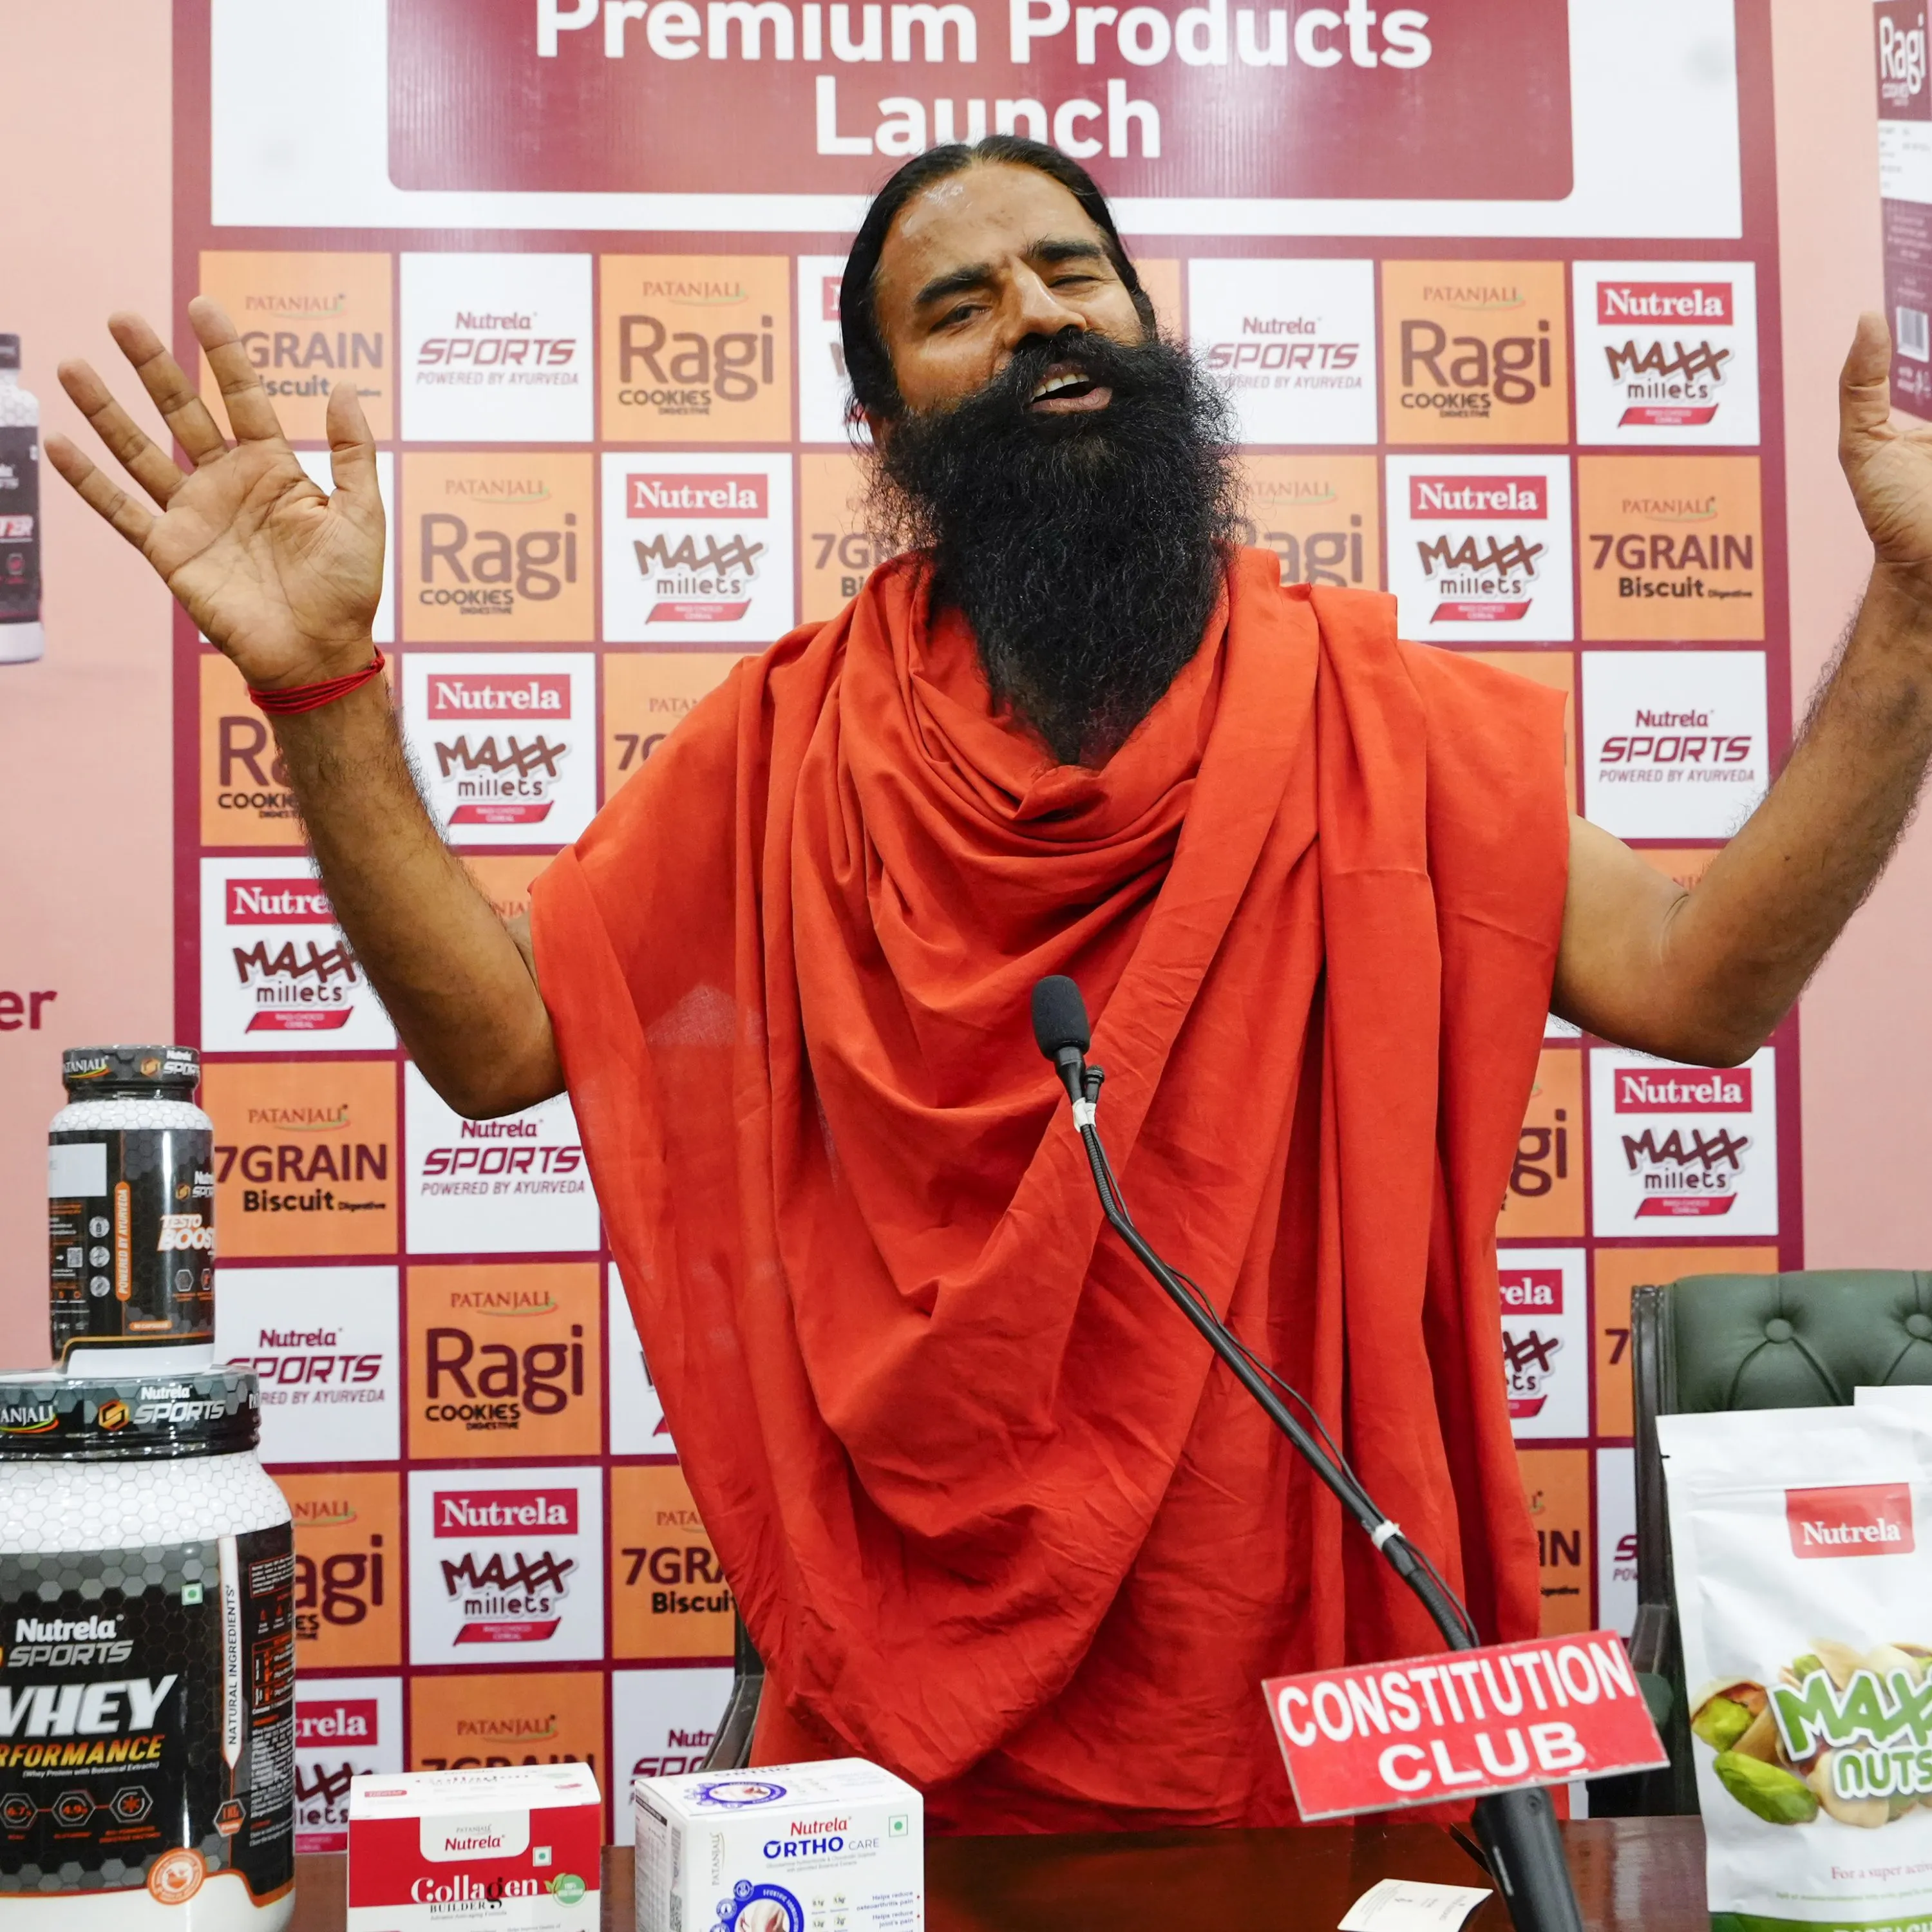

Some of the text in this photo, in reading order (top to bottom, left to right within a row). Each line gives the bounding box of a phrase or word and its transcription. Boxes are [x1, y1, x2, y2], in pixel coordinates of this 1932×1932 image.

[537, 0, 1433, 69] Premium Products
[1879, 13, 1926, 95] Ragi
[815, 75, 1162, 158] Launch
[643, 281, 742, 299] PATANJALI
[1423, 286, 1520, 305] PATANJALI
[245, 294, 340, 312] PATANJALI
[1604, 289, 1725, 317] Nutrela
[455, 312, 531, 330] Nutrela
[1243, 317, 1316, 335] Nutrela
[240, 331, 383, 370] GRAIN
[417, 339, 576, 366] SPORTS
[619, 314, 775, 402] Ragi
[1208, 343, 1359, 370] SPORTS
[1400, 320, 1551, 405] Ragi
[1604, 341, 1731, 381] MAXX
[259, 374, 330, 397] scuit
[416, 372, 579, 386] POWERED BY AYURVEDA
[1274, 376, 1291, 388] BY
[1294, 375, 1363, 389] AYURVEDA
[1627, 380, 1709, 399] millets
[618, 390, 712, 406] COOKIES
[1401, 393, 1492, 409] COOKIES
[445, 479, 544, 497] PATANJALI
[634, 481, 759, 509] Nutrela
[1417, 482, 1539, 511] Nutrela
[1622, 498, 1710, 515] PATANJALI
[420, 513, 577, 601] Ragi
[632, 534, 764, 576] MAXX
[1416, 535, 1544, 576] MAXX
[1589, 534, 1754, 571] 7GRAIN
[656, 574, 741, 595] millets
[1439, 574, 1522, 594] millets
[1618, 576, 1704, 598] Biscuit
[419, 589, 514, 605] COOKIES
[434, 682, 562, 709] Nutrela
[1635, 710, 1709, 728] Nutrela
[434, 735, 567, 778] MAXX
[1599, 736, 1752, 762] SPORTS
[458, 776, 543, 796] millets
[1599, 769, 1755, 782] POWERED BY AYURVEDA
[218, 793, 295, 809] COOKI
[232, 887, 330, 915] Nutre
[256, 981, 342, 1003] millets
[0, 990, 58, 1030] er
[1622, 1075, 1744, 1104] Nutrela
[248, 1106, 344, 1126] PATANJALI
[461, 1120, 538, 1139] Nutrela
[422, 1146, 582, 1175] SPORTS
[1510, 1108, 1567, 1198] gi
[1622, 1128, 1748, 1171] MAXX
[215, 1142, 386, 1183] 7GRAIN
[421, 1180, 585, 1196] POWERED BY AYURVEDA
[1644, 1168, 1727, 1189] millets
[243, 1189, 334, 1211] Biscuit
[451, 1291, 550, 1310] PATANJALI
[260, 1328, 337, 1348] Nutrela
[425, 1323, 585, 1415] Ragi
[140, 1385, 191, 1401] Nutrela
[292, 1391, 310, 1405] BY
[313, 1389, 386, 1404] AYURVEDA
[0, 1405, 53, 1426] ANJALI
[133, 1400, 227, 1425] SPORTS
[425, 1403, 521, 1422] COOKIES
[294, 1501, 349, 1519] NJALI
[441, 1497, 567, 1528] Nutrela
[1801, 1517, 1902, 1546] Nutrela
[440, 1551, 574, 1596] MAXX
[621, 1547, 725, 1586] 7GR
[295, 1534, 383, 1625] agi
[463, 1594, 550, 1615] millets
[652, 1589, 734, 1614] Biscui
[15, 1615, 117, 1643] Nutrela
[8, 1640, 135, 1667] SPORTS
[225, 1588, 238, 1745] NATURAL INGREDIENTS
[1278, 1639, 1637, 1748] CONSTITUTION
[296, 1708, 368, 1738] rela
[456, 1718, 551, 1737] PATANJALI
[668, 1728, 717, 1748] Nutr
[0, 1734, 166, 1768] RFORMANCE
[1378, 1721, 1587, 1792] CLUB
[790, 1817, 848, 1837] Nutrela
[444, 1834, 502, 1851] Nutrela
[763, 1836, 880, 1859] ORTHO CARE
[1831, 1866, 1855, 1879] For
[411, 1874, 538, 1909] Collagen
[430, 1902, 487, 1914] BUILDER
